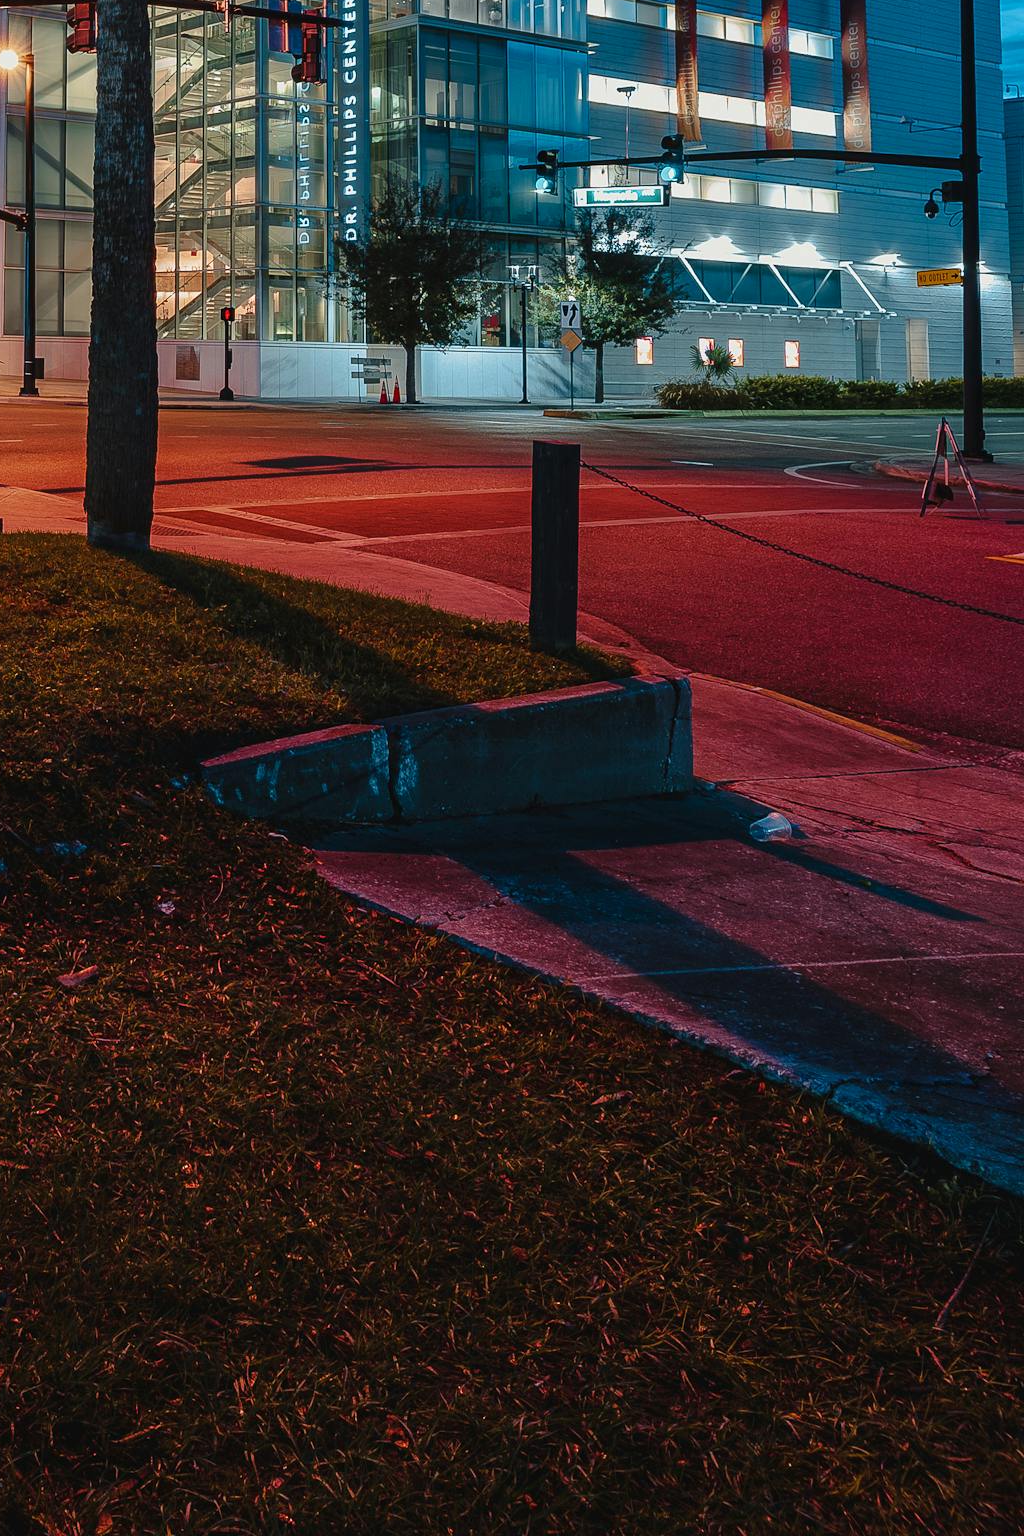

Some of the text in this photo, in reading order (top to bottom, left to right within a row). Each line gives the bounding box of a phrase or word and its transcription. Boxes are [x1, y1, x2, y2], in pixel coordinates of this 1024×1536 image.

[769, 6, 781, 53] center
[768, 58, 786, 114] phillips
[847, 22, 865, 148] dr. phillips center
[343, 96, 357, 195] PHILLIPS
[344, 206, 357, 241] DR.
[928, 273, 949, 282] OUTLET
